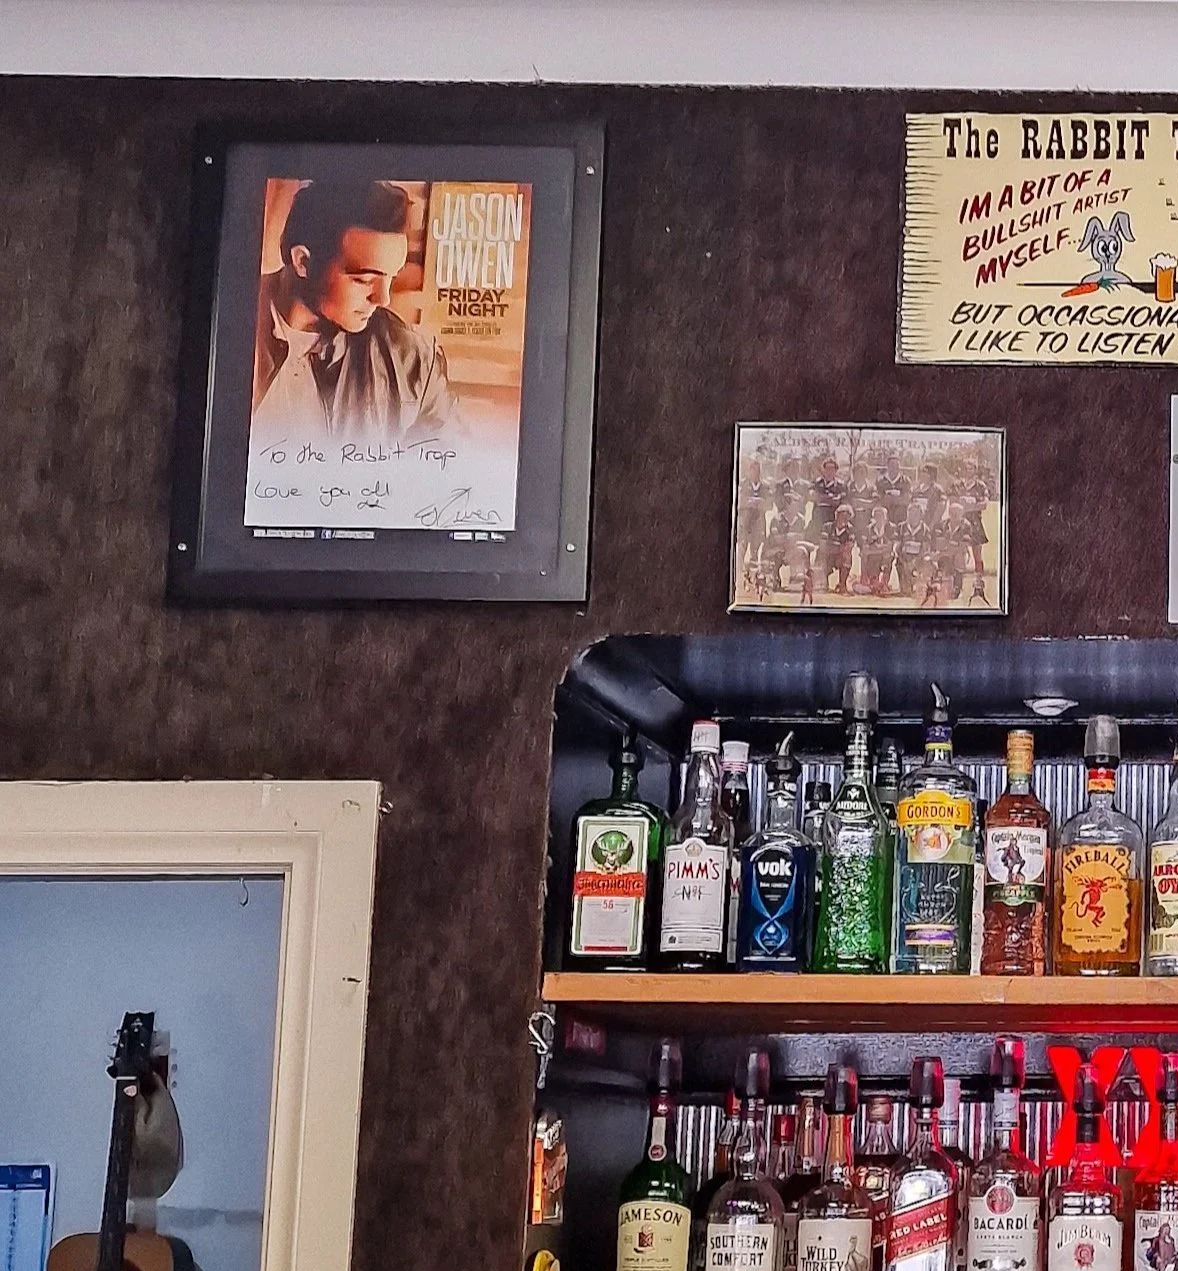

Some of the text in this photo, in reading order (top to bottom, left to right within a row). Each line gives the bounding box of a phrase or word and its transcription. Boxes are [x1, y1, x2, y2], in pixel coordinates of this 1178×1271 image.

[942, 118, 999, 159] The
[1021, 118, 1149, 160] RABBIT
[959, 169, 1111, 224] IM A BIT OF A
[432, 193, 523, 241] JASON
[962, 188, 1132, 262] BULLSHIT ARTIST
[436, 241, 514, 289] OWEN
[437, 288, 505, 303] FRIDAY
[448, 303, 509, 317] NIGHT
[950, 301, 1013, 326] BUT
[948, 332, 960, 352] I
[965, 330, 1027, 353] LIKE
[1035, 333, 1069, 353] TO
[1077, 333, 1173, 356] LISTEN
[260, 439, 457, 470] To the Rabbit Trap
[254, 481, 302, 499] Love
[907, 805, 961, 819] GORDON'S
[667, 858, 720, 880] PIMM'S
[758, 859, 792, 876] vok
[1065, 850, 1127, 875] FIREBALL
[620, 1208, 682, 1228] JAMESON
[890, 1225, 910, 1240] RED
[913, 1213, 947, 1231] LABEL
[974, 1214, 1028, 1230] BACARDÍ
[710, 1235, 769, 1250] SOUTHERN
[806, 1245, 837, 1261] WILD
[712, 1252, 764, 1267] COMFORT
